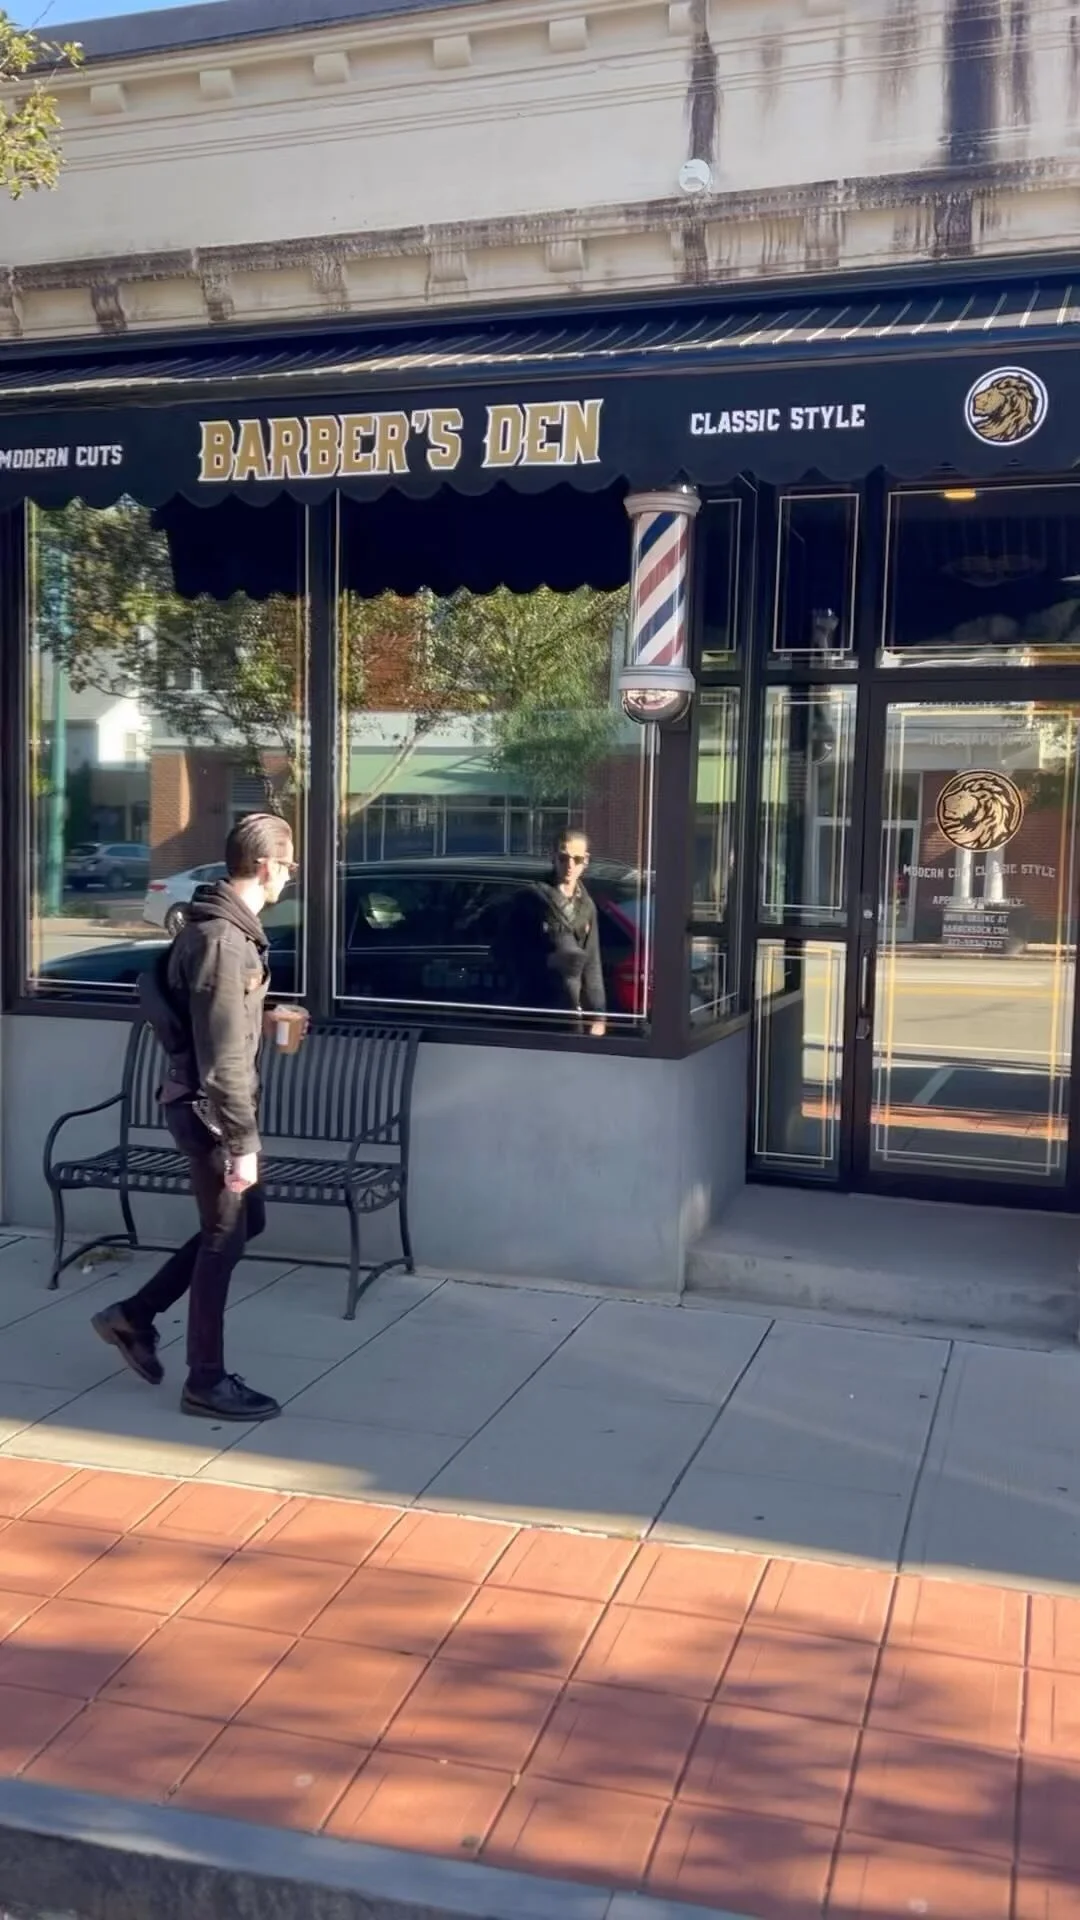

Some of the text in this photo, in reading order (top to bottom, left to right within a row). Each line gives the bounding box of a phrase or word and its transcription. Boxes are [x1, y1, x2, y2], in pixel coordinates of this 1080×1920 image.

[689, 403, 867, 436] CLASSIC STYLE
[197, 398, 604, 482] BARBER'S DEN
[0, 444, 124, 469] MODERN CUTS
[902, 863, 944, 879] MODERN
[1020, 862, 1057, 879] STYLE
